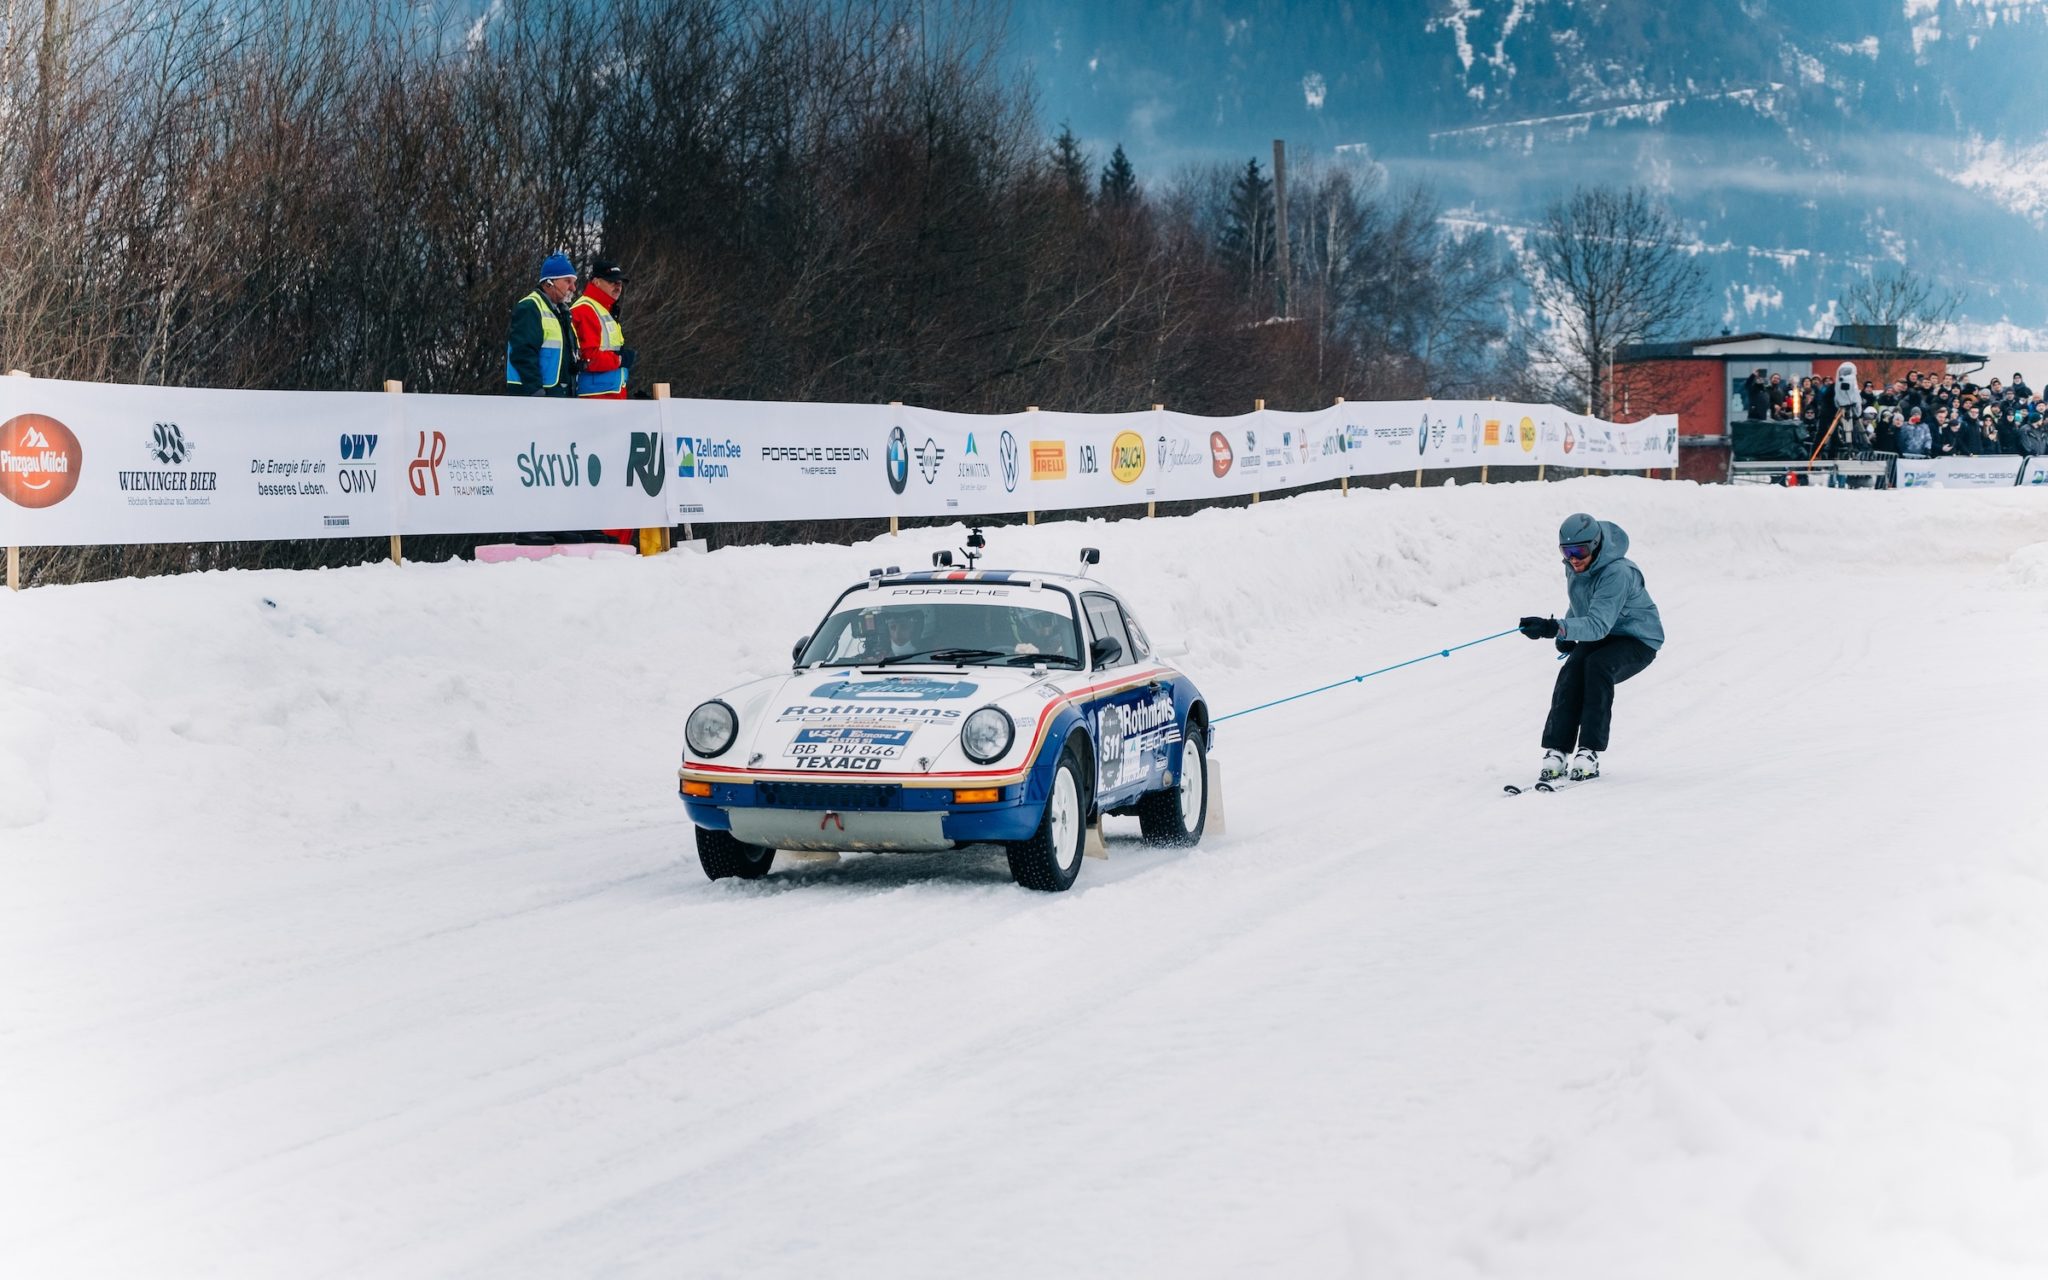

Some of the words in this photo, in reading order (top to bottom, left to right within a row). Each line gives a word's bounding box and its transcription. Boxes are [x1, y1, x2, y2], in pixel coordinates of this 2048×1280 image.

[696, 438, 712, 457] Zell
[726, 439, 741, 458] See
[762, 447, 823, 461] PORSCHE
[826, 447, 869, 461] DESIGN
[1120, 446, 1142, 469] RAUCH
[0, 450, 40, 478] Pinzgau
[40, 450, 68, 472] Milch
[251, 459, 265, 473] Die
[267, 459, 298, 477] Energie
[300, 459, 312, 473] für
[313, 460, 326, 473] ein
[447, 459, 490, 470] HANS-PETER
[517, 442, 579, 487] skruf
[1033, 448, 1065, 473] PIRELLI
[119, 471, 187, 491] WIENINGER
[190, 471, 217, 491] BIER
[338, 469, 377, 493] OMV
[449, 471, 494, 481] PORSCHE
[697, 459, 728, 484] Kaprun
[258, 482, 297, 495] besseres
[298, 482, 328, 495] Leben.
[453, 485, 495, 496] TRAUMWERK
[892, 589, 1010, 598] PORSCHE
[782, 705, 962, 718] Rothmans
[1122, 697, 1175, 737] Rothmans
[792, 744, 818, 755] BB
[830, 745, 856, 755] PW
[859, 746, 895, 757] 846
[1102, 734, 1120, 762] S11
[796, 757, 882, 770] TEXACO
